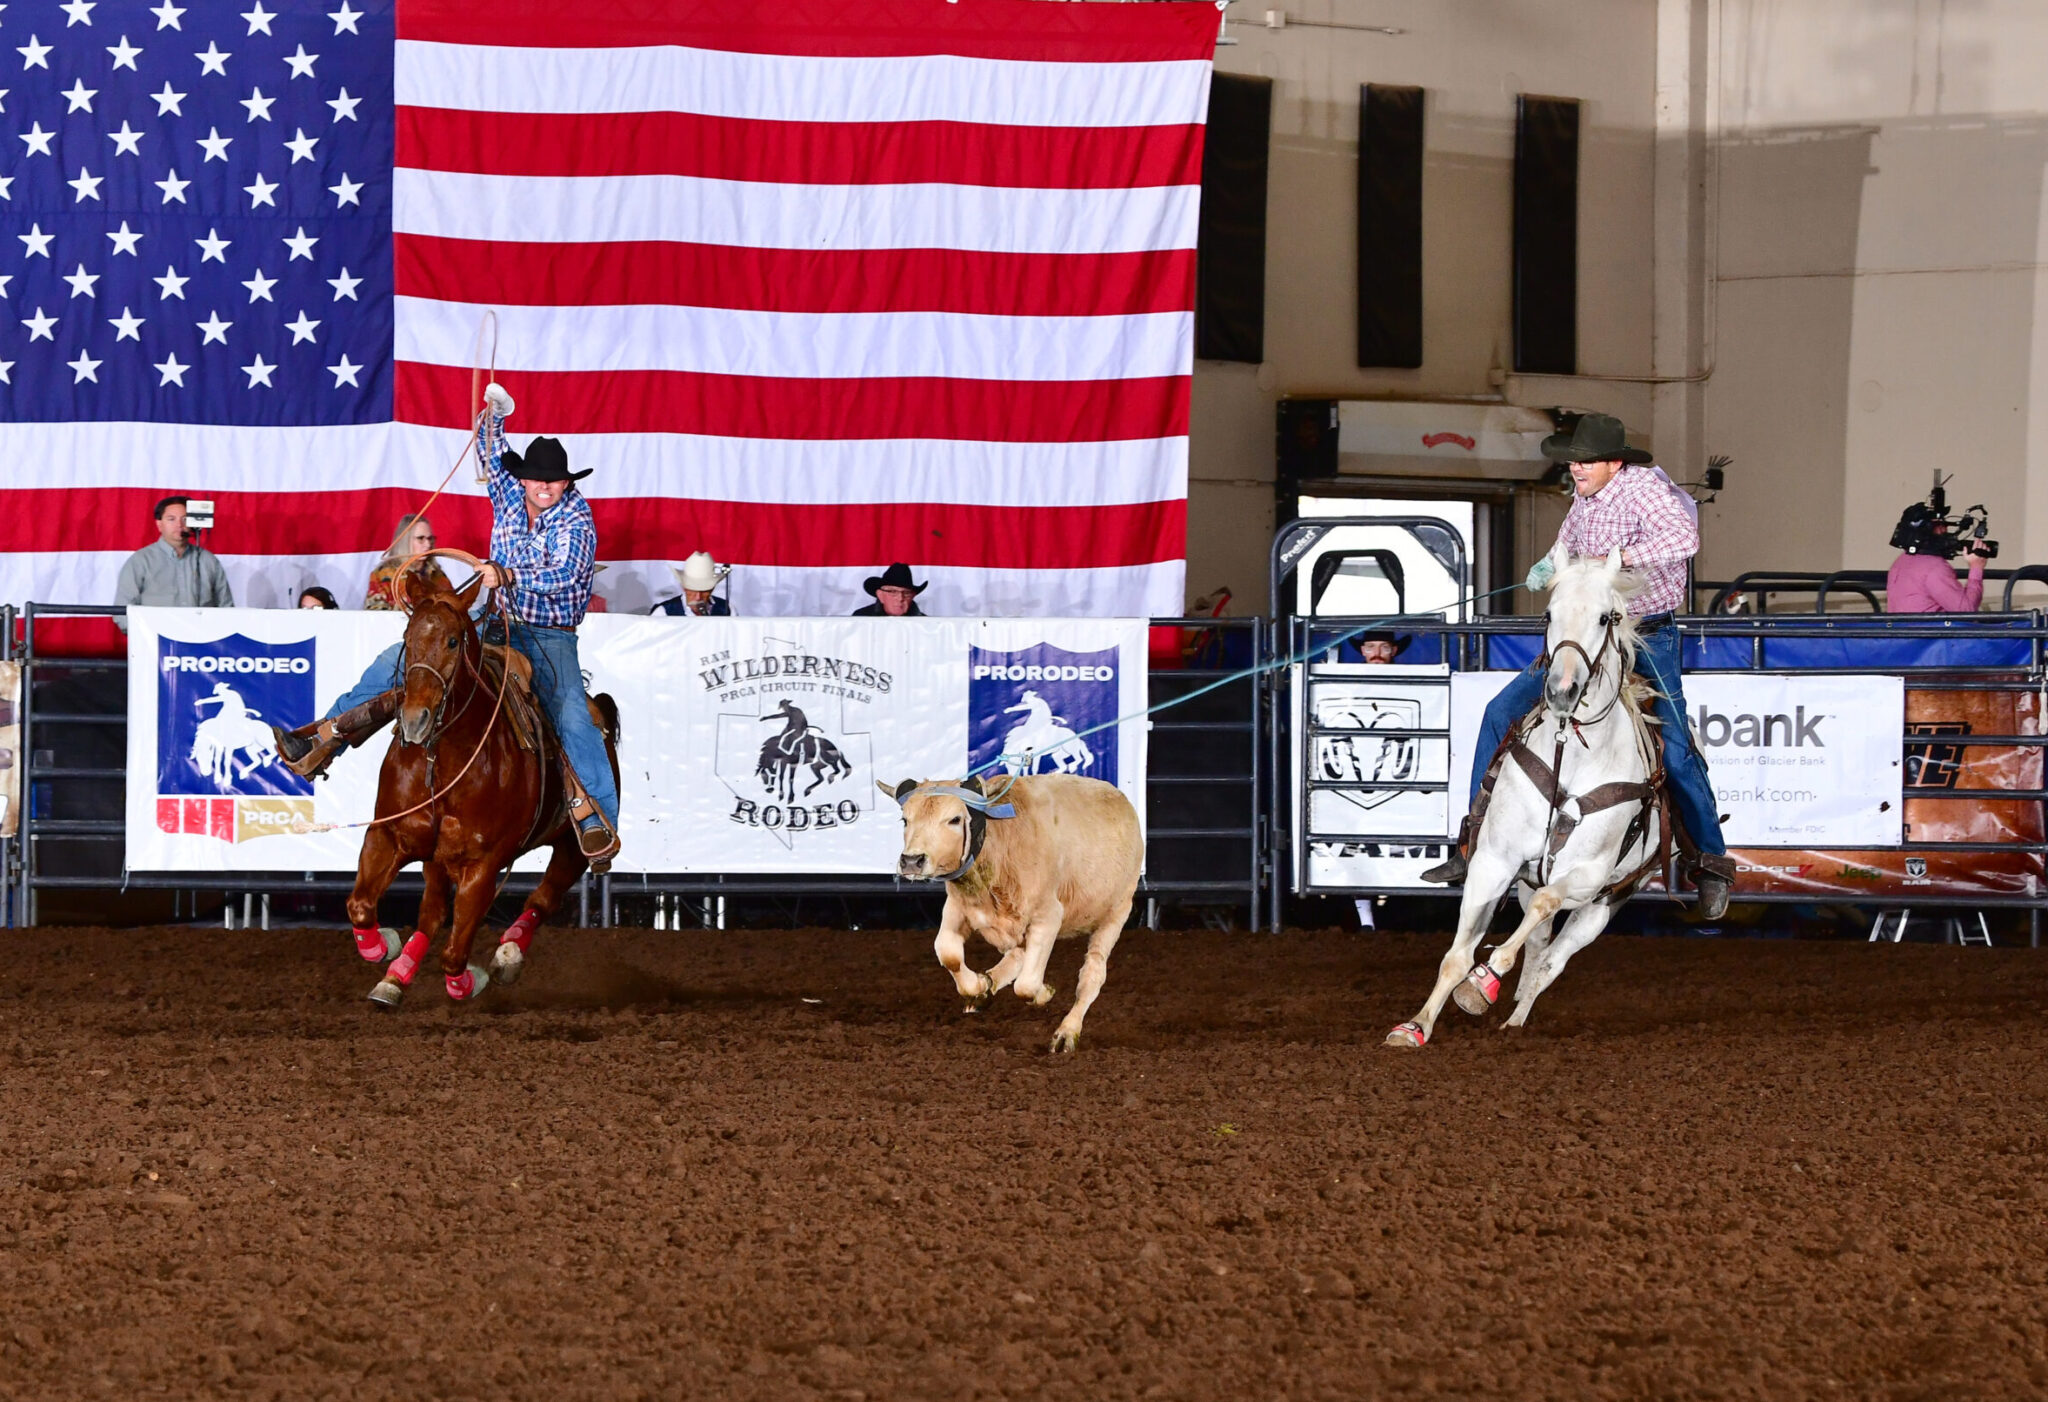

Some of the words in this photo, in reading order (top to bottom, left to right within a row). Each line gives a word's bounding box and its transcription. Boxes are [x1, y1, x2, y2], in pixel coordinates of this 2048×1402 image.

[163, 656, 311, 674] PRORODEO
[700, 649, 731, 666] RAM
[698, 655, 893, 694] WILDERNESS
[974, 665, 1114, 682] PRORODEO
[720, 686, 757, 703] PRCA
[760, 681, 817, 694] CIRCUIT
[822, 684, 873, 704] FINALS
[1687, 704, 1826, 748] bank
[1706, 755, 1740, 766] ivision
[1744, 755, 1755, 766] of
[1758, 755, 1796, 766] Glacier
[1799, 755, 1826, 766] Bank
[244, 810, 307, 825] PRCA
[730, 795, 860, 832] RODEO
[1736, 864, 1802, 874] ODGE
[1836, 864, 1883, 881] Jeep
